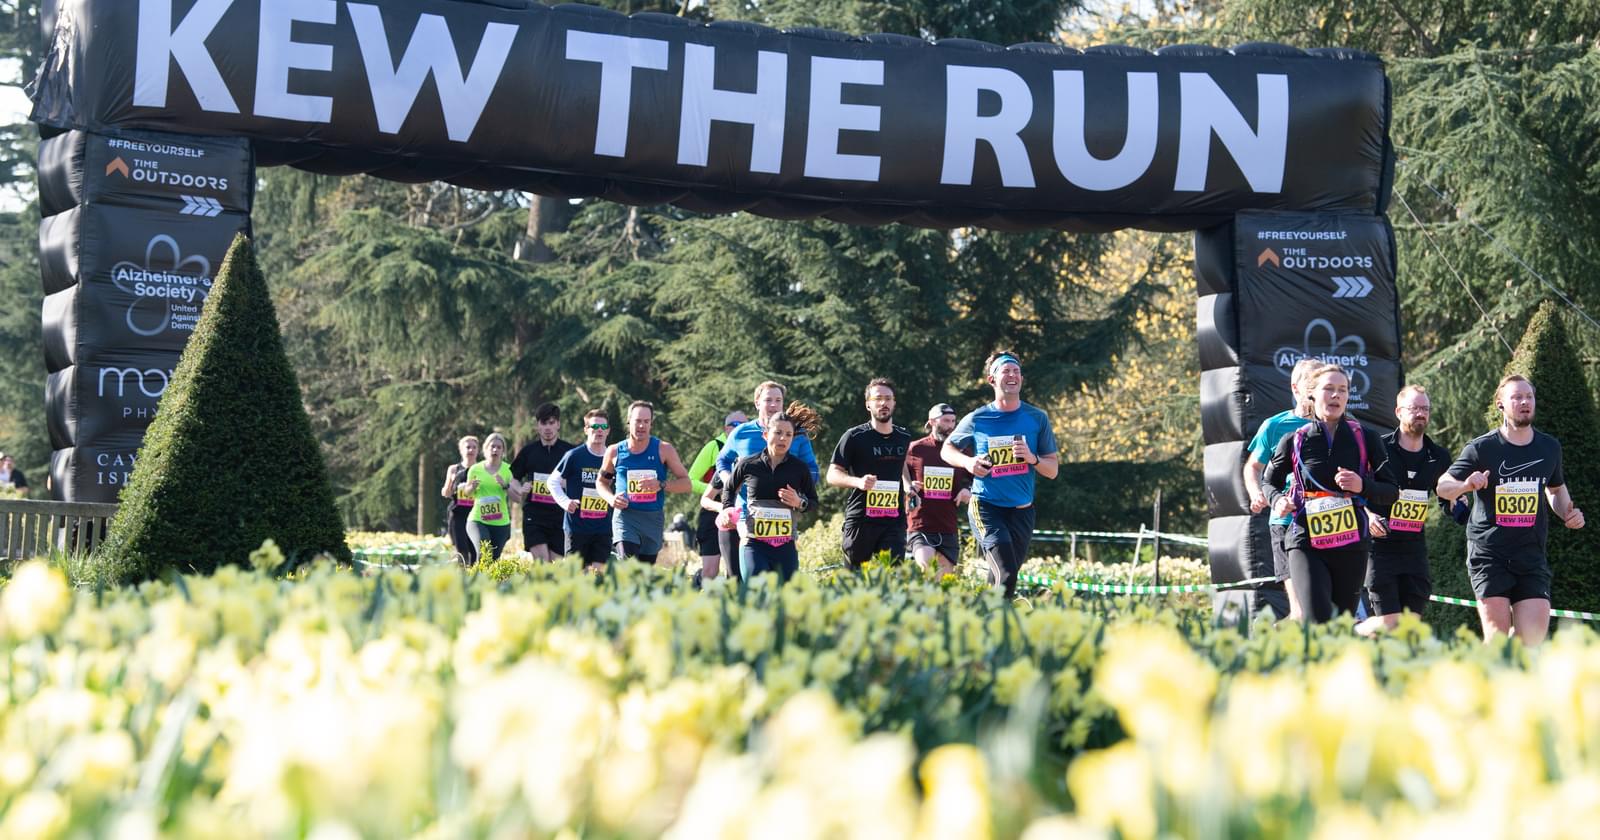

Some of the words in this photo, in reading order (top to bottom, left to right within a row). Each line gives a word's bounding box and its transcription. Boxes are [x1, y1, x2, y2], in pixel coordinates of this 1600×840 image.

[133, 0, 519, 142] KEW
[565, 29, 884, 182] THE
[940, 64, 1289, 193] RUN
[108, 139, 205, 158] #FREEYOURSELF
[134, 159, 158, 169] TIME
[132, 168, 228, 190] OUTDOORS
[1257, 231, 1348, 240] #FREEYOURSELF
[1282, 247, 1307, 256] TIME
[1283, 256, 1373, 269] OUTDOORS
[117, 268, 212, 287] Alzheimer's
[134, 282, 197, 303] Society
[171, 304, 197, 313] United
[925, 476, 951, 490] 0205
[584, 498, 607, 510] 1762
[869, 492, 897, 507] 0224
[1497, 496, 1537, 514] 0302
[480, 503, 500, 515] 0361
[1393, 501, 1428, 520] 0357
[756, 520, 790, 536] 0715
[1311, 509, 1354, 535] 0370
[1336, 533, 1356, 542] HALF
